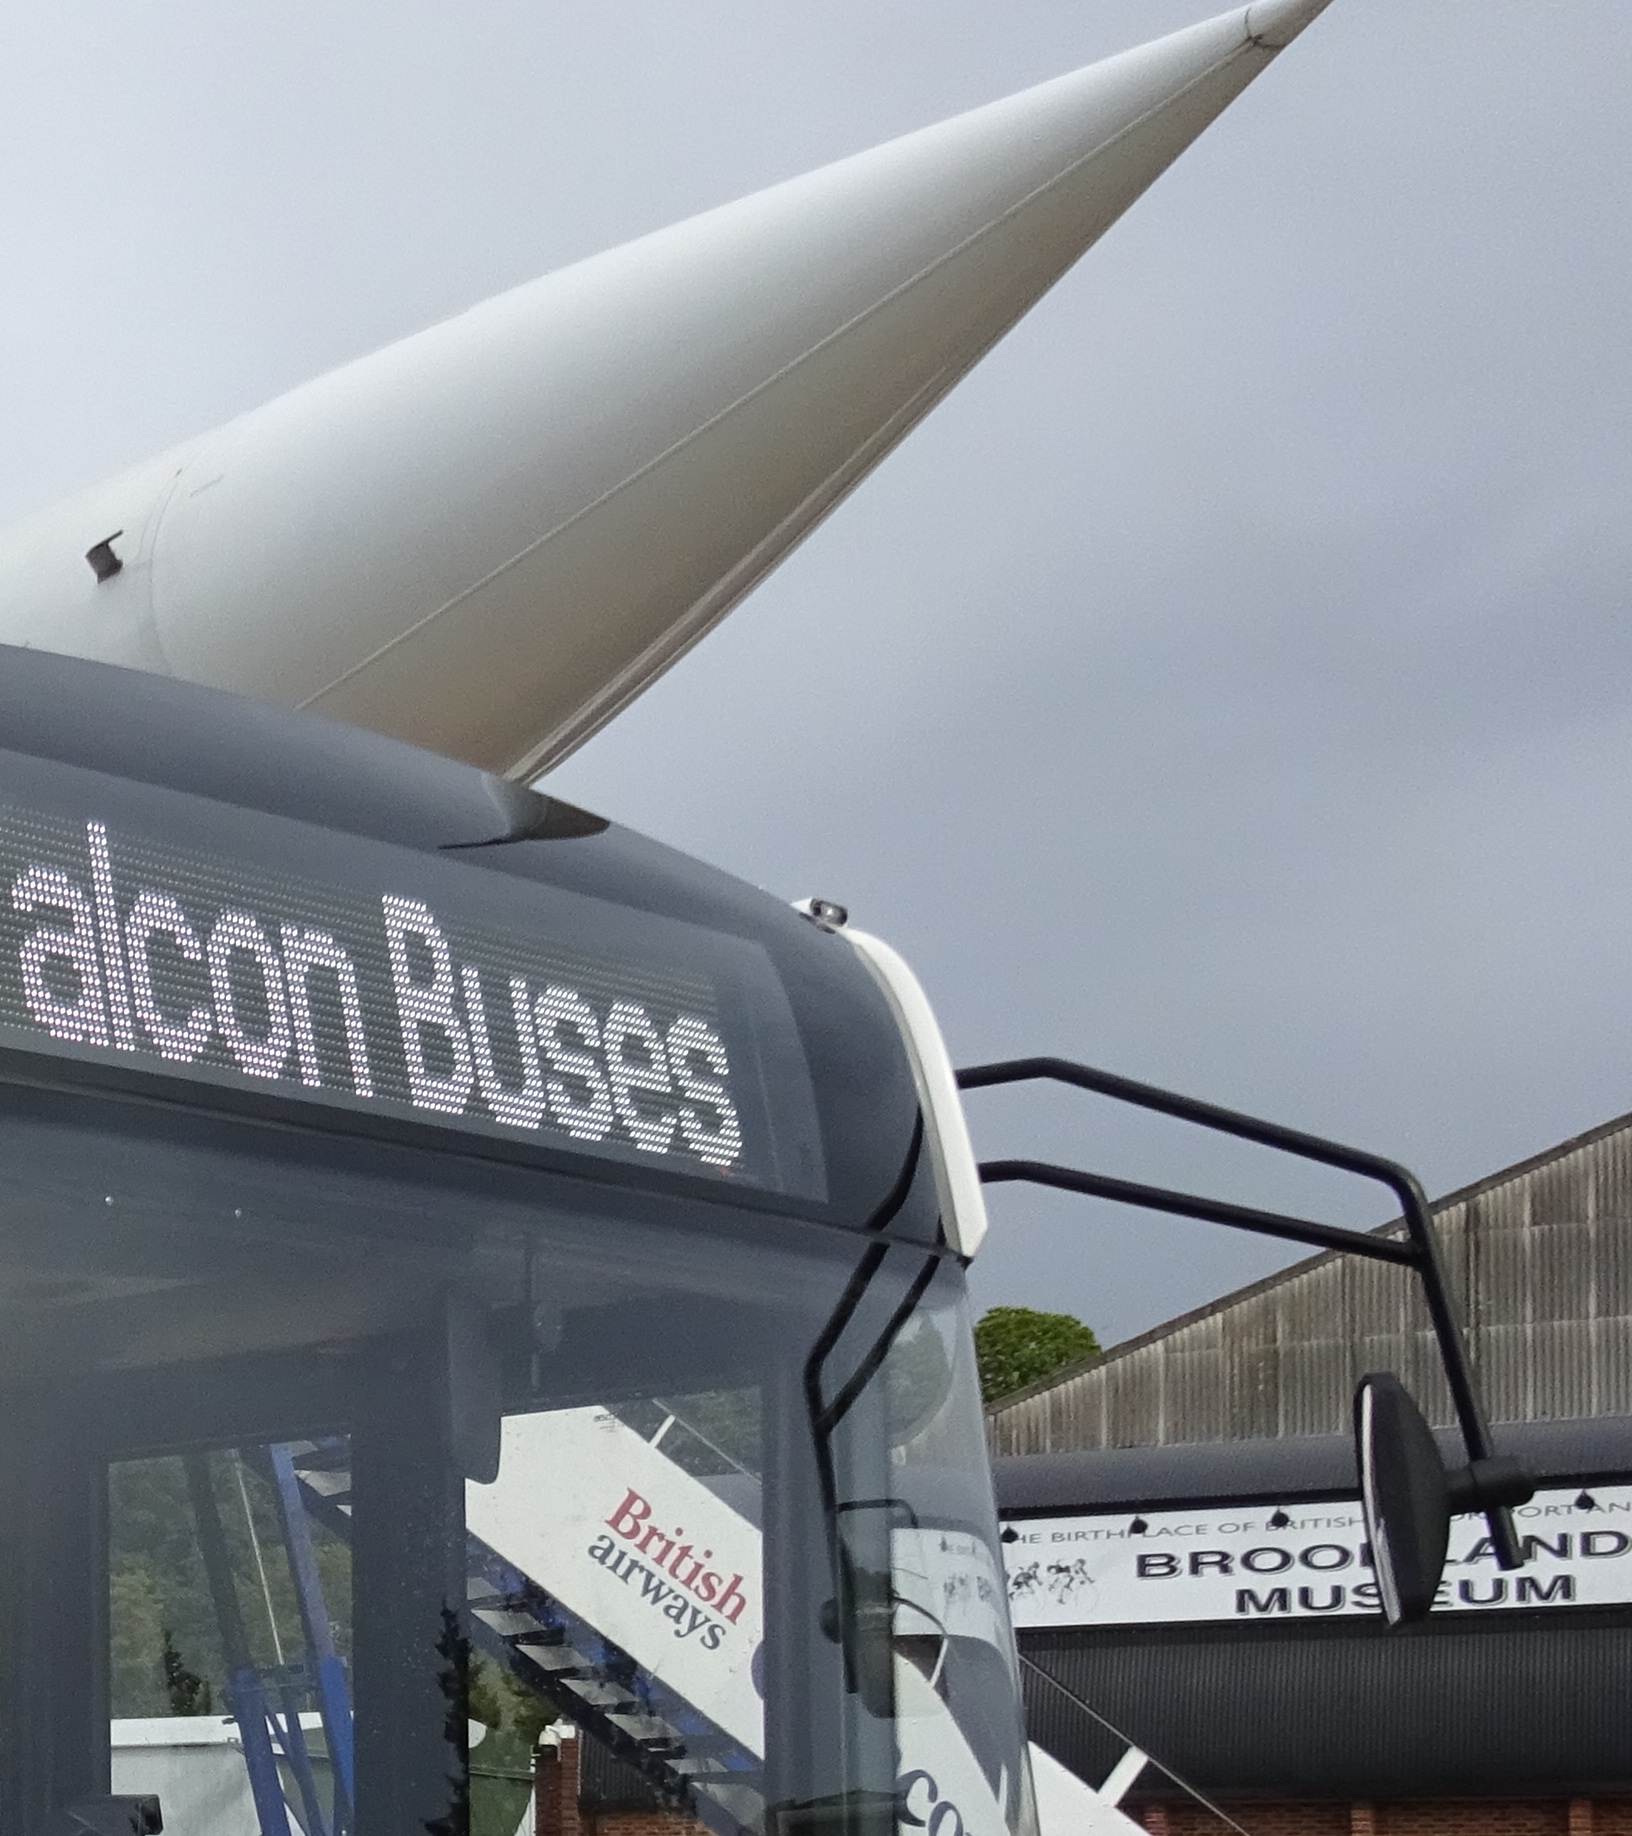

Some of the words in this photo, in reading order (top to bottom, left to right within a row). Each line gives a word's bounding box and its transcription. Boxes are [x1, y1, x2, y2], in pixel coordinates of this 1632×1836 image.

[382, 894, 742, 1168] Buses
[604, 1486, 749, 1626] British
[1050, 1522, 1209, 1543] BIRTHLACE
[1216, 1521, 1256, 1536] OF
[1136, 1530, 1632, 1580] BROOAND
[587, 1533, 728, 1652] airways
